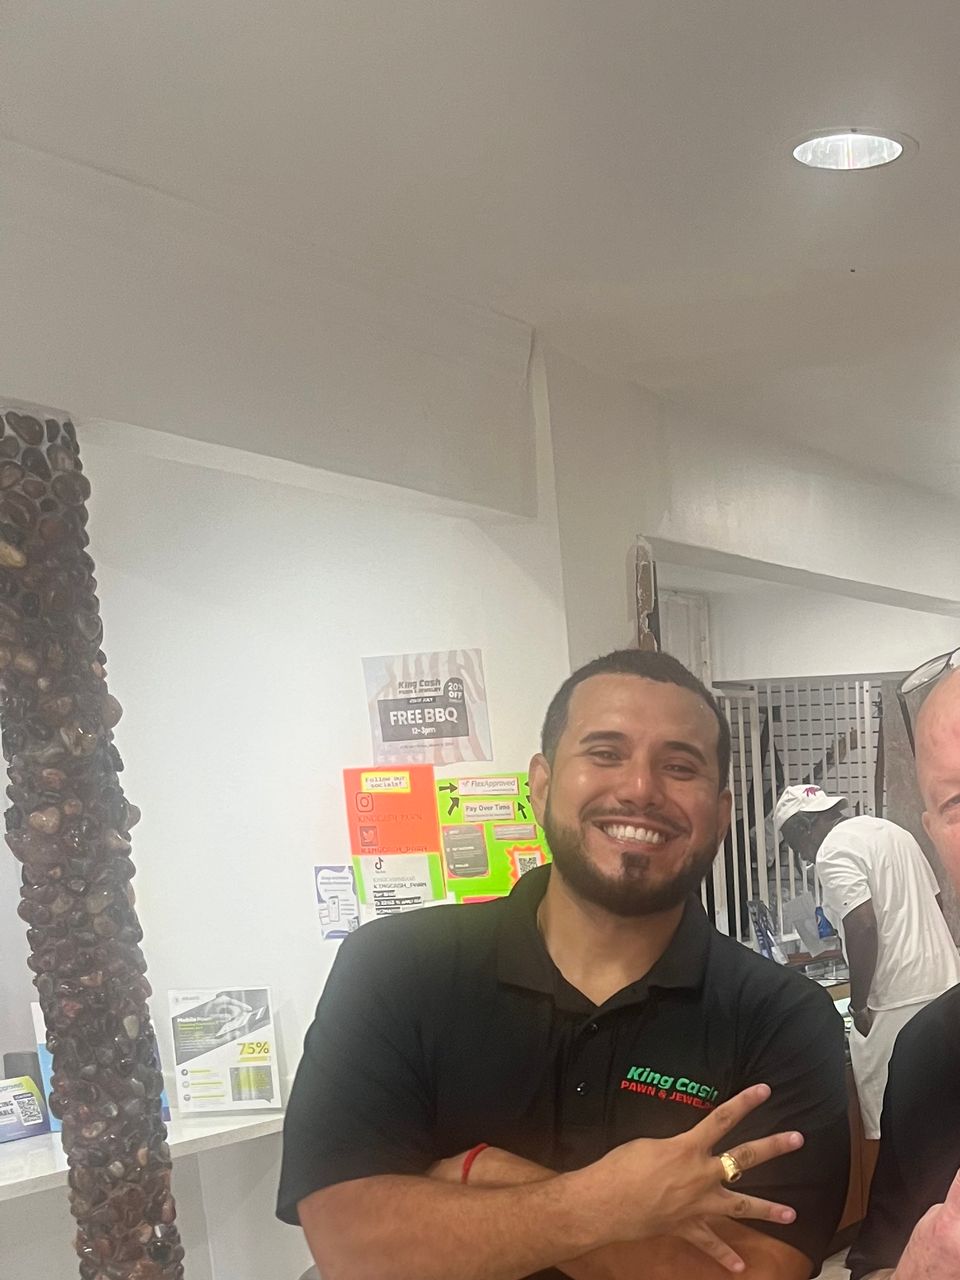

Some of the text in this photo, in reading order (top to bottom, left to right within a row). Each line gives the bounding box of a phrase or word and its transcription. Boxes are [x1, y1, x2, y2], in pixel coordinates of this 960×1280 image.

[419, 678, 441, 688] Cash
[448, 691, 463, 699] OFF
[389, 707, 459, 726] FREE BBQ
[465, 805, 477, 813] Pay
[495, 803, 511, 811] Time
[237, 1041, 270, 1055] 75%
[626, 1066, 674, 1089] King
[619, 1080, 656, 1097] PAWN
[657, 1090, 666, 1099] &
